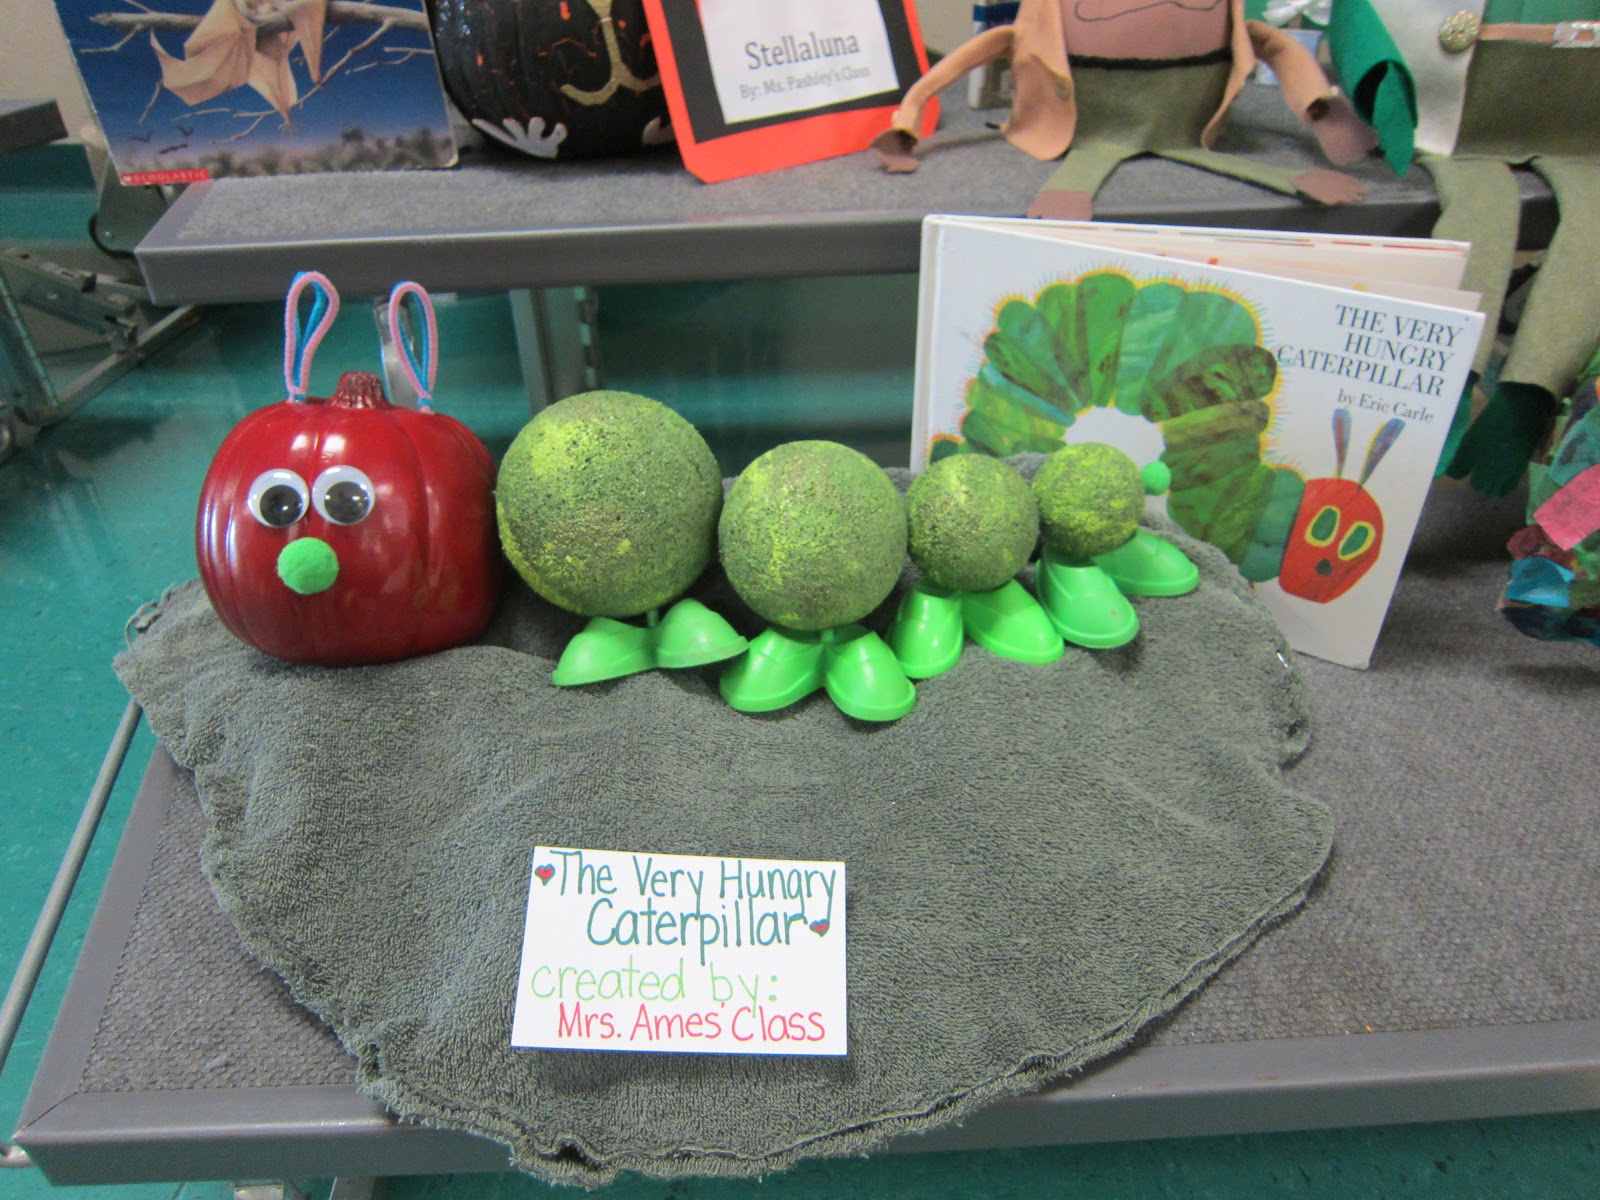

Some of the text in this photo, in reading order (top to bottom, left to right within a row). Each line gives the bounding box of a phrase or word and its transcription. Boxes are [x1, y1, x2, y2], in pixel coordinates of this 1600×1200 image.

[744, 32, 860, 70] Stellaluna
[739, 84, 762, 101] By:
[1335, 304, 1464, 348] THE VERY
[1277, 344, 1445, 398] CATERPILLAR
[1344, 332, 1455, 373] HUNGRY
[1337, 388, 1435, 423] by Eric Carle
[550, 850, 837, 922] The Very Hungry
[587, 897, 808, 966] Caterpillar
[531, 954, 778, 1018] created by:
[557, 1001, 622, 1039] Mrs.
[731, 1005, 826, 1041] Class
